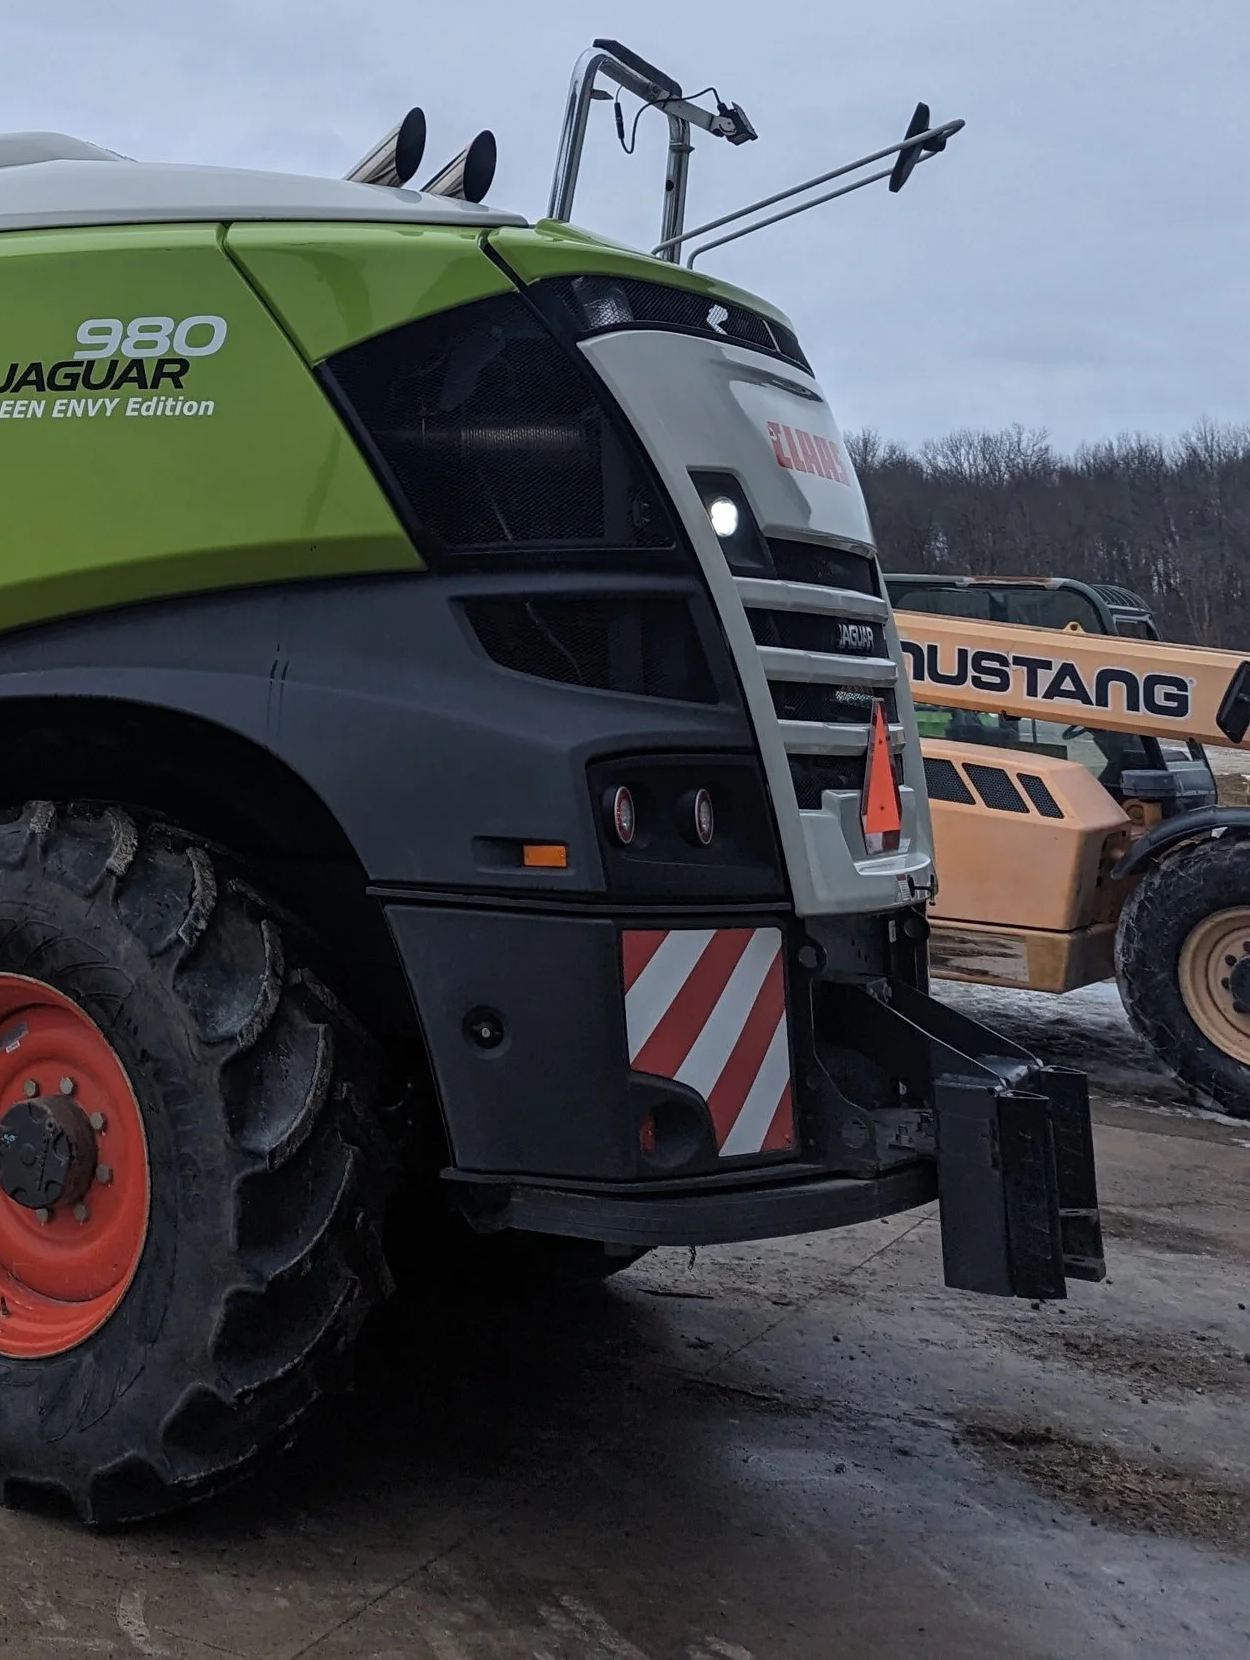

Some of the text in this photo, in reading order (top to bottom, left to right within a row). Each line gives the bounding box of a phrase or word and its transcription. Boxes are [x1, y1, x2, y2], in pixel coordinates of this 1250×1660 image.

[73, 315, 228, 360] 980
[51, 398, 120, 419] ENVY
[125, 396, 215, 417] Edition
[766, 420, 851, 487] CLAAS
[838, 623, 874, 650] JAGUAR
